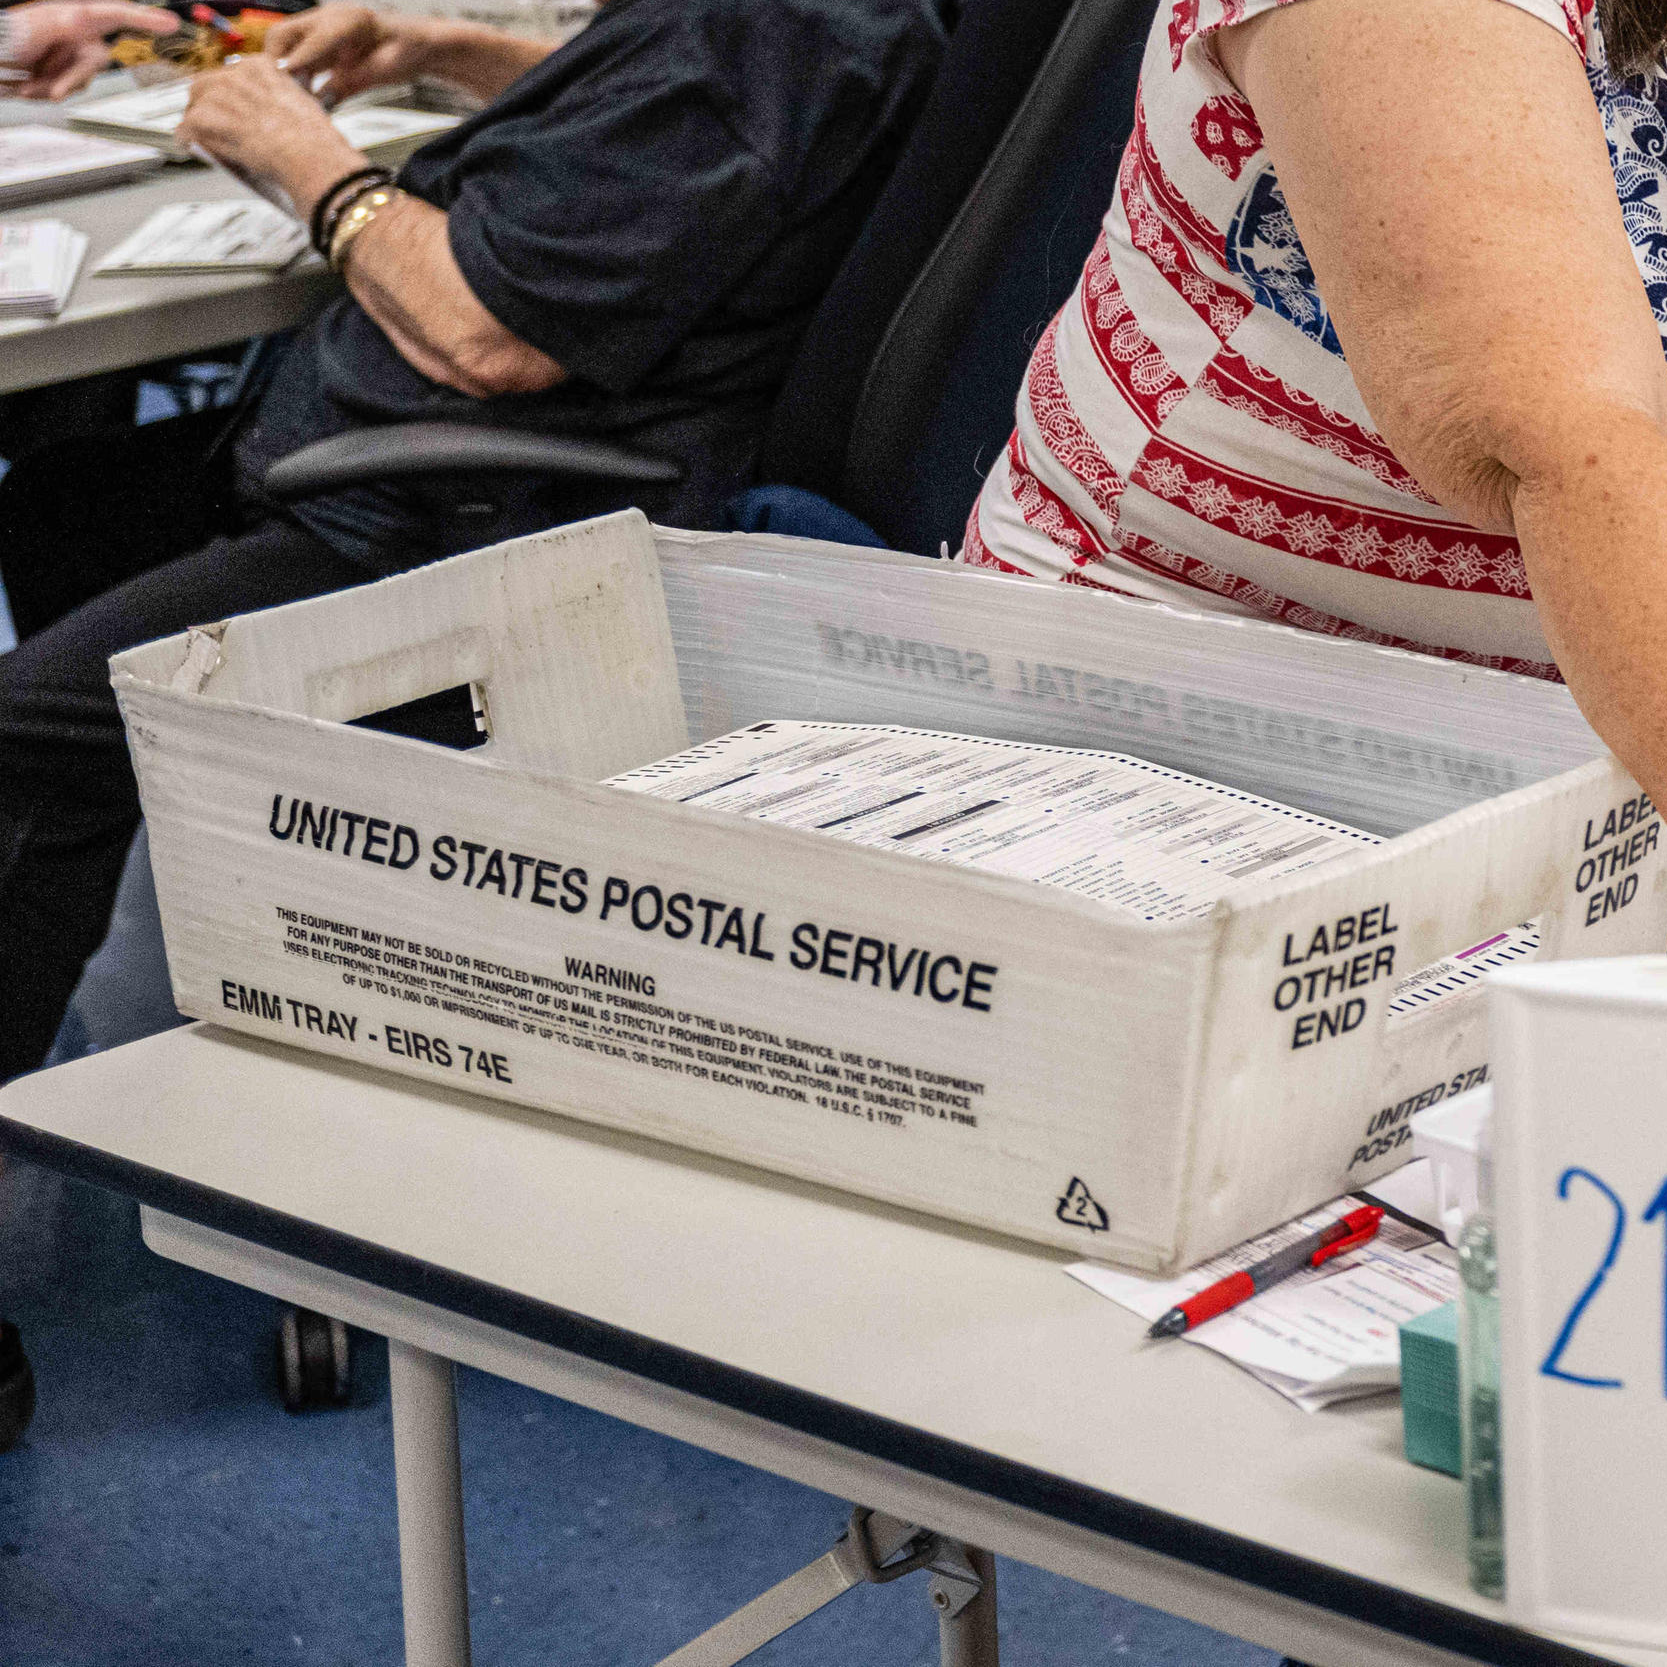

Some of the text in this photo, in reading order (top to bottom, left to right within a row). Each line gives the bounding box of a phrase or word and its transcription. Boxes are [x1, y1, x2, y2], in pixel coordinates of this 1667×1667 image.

[1575, 821, 1661, 893] OTHER
[1583, 792, 1656, 852] LABE
[270, 793, 999, 1012] UNITED STATES POSTAL SERVICE
[1282, 902, 1398, 967] LABEL
[1585, 872, 1638, 927] END
[275, 907, 985, 1095] THIS EQUIPMENT MAY NOT BE SOLD OR RECYCLED WITHOUT THE PERMISSION OF THE US POSTAL SERVICE. USE OF THIS EQUIPMENT
[564, 955, 656, 996] WARNING
[1274, 944, 1396, 1011] OTHER
[221, 979, 282, 1024] EMM
[286, 998, 358, 1042] TRAY
[385, 1025, 452, 1067] EIRS
[458, 1045, 513, 1084] 74E
[287, 926, 971, 1109] FOR ANY PURPOSE OTHER THAN THE TRANSPORT OF US MAIL IS STRICTLY PROHIBITED BY FEDERAL LAW. THE POSTAL SERVICE
[342, 974, 357, 987] OF
[359, 978, 373, 991] UP
[375, 983, 389, 995] TO
[424, 994, 440, 1009] OR
[442, 999, 520, 1031] IMPRISONMENT
[522, 1022, 537, 1035] OF
[539, 1027, 555, 1039] UP
[557, 1033, 570, 1045] TO
[572, 1035, 595, 1051] ONE
[632, 1051, 649, 1063] OR
[651, 1055, 682, 1073] BOTH
[684, 1063, 708, 1076] FOR
[711, 1068, 743, 1085] EACH
[745, 1079, 809, 1103] VIOLATION.
[1291, 998, 1366, 1050] END
[1366, 1063, 1493, 1137] UNITED STA
